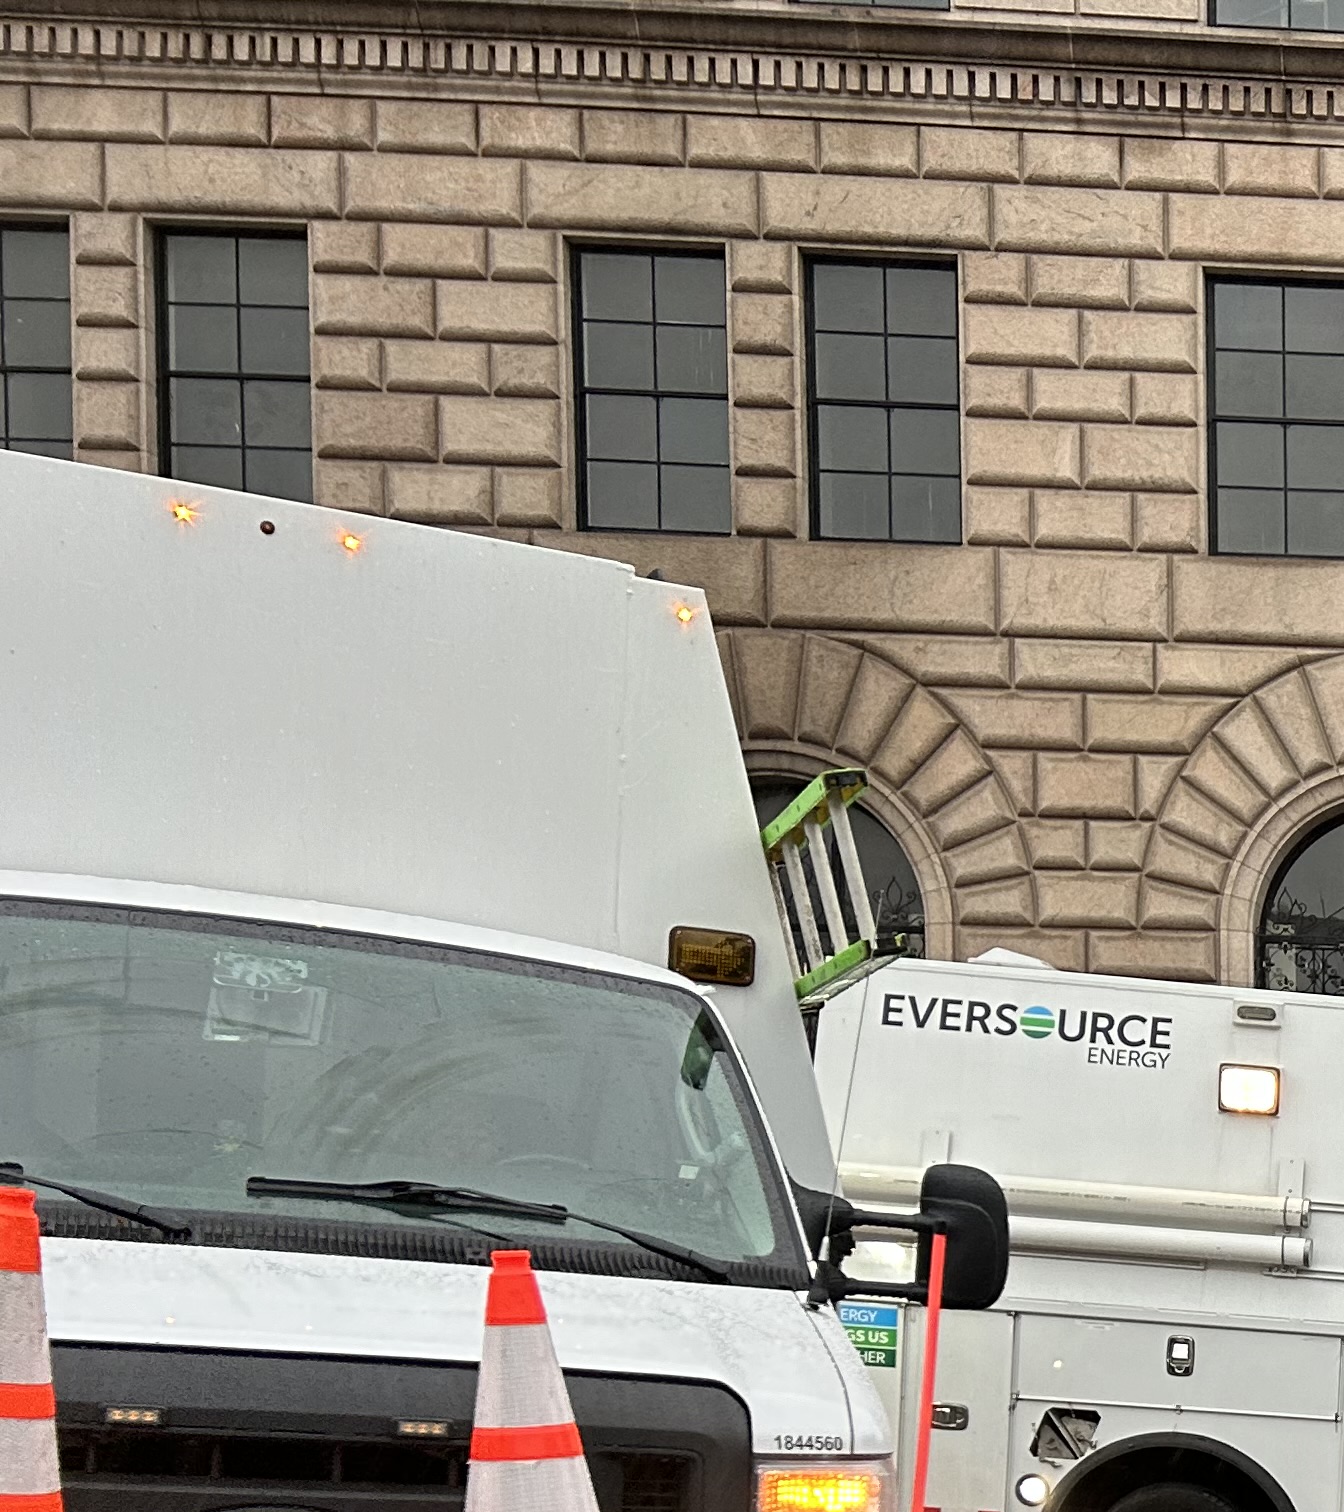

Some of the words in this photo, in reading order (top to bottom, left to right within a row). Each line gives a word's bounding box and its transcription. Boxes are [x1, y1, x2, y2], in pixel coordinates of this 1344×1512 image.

[881, 993, 1173, 1050] EVERSOURCE
[1087, 1047, 1171, 1069] ENERGY
[840, 1308, 878, 1322] ERGY
[868, 1330, 889, 1343] US
[774, 1434, 843, 1450] 1844560
